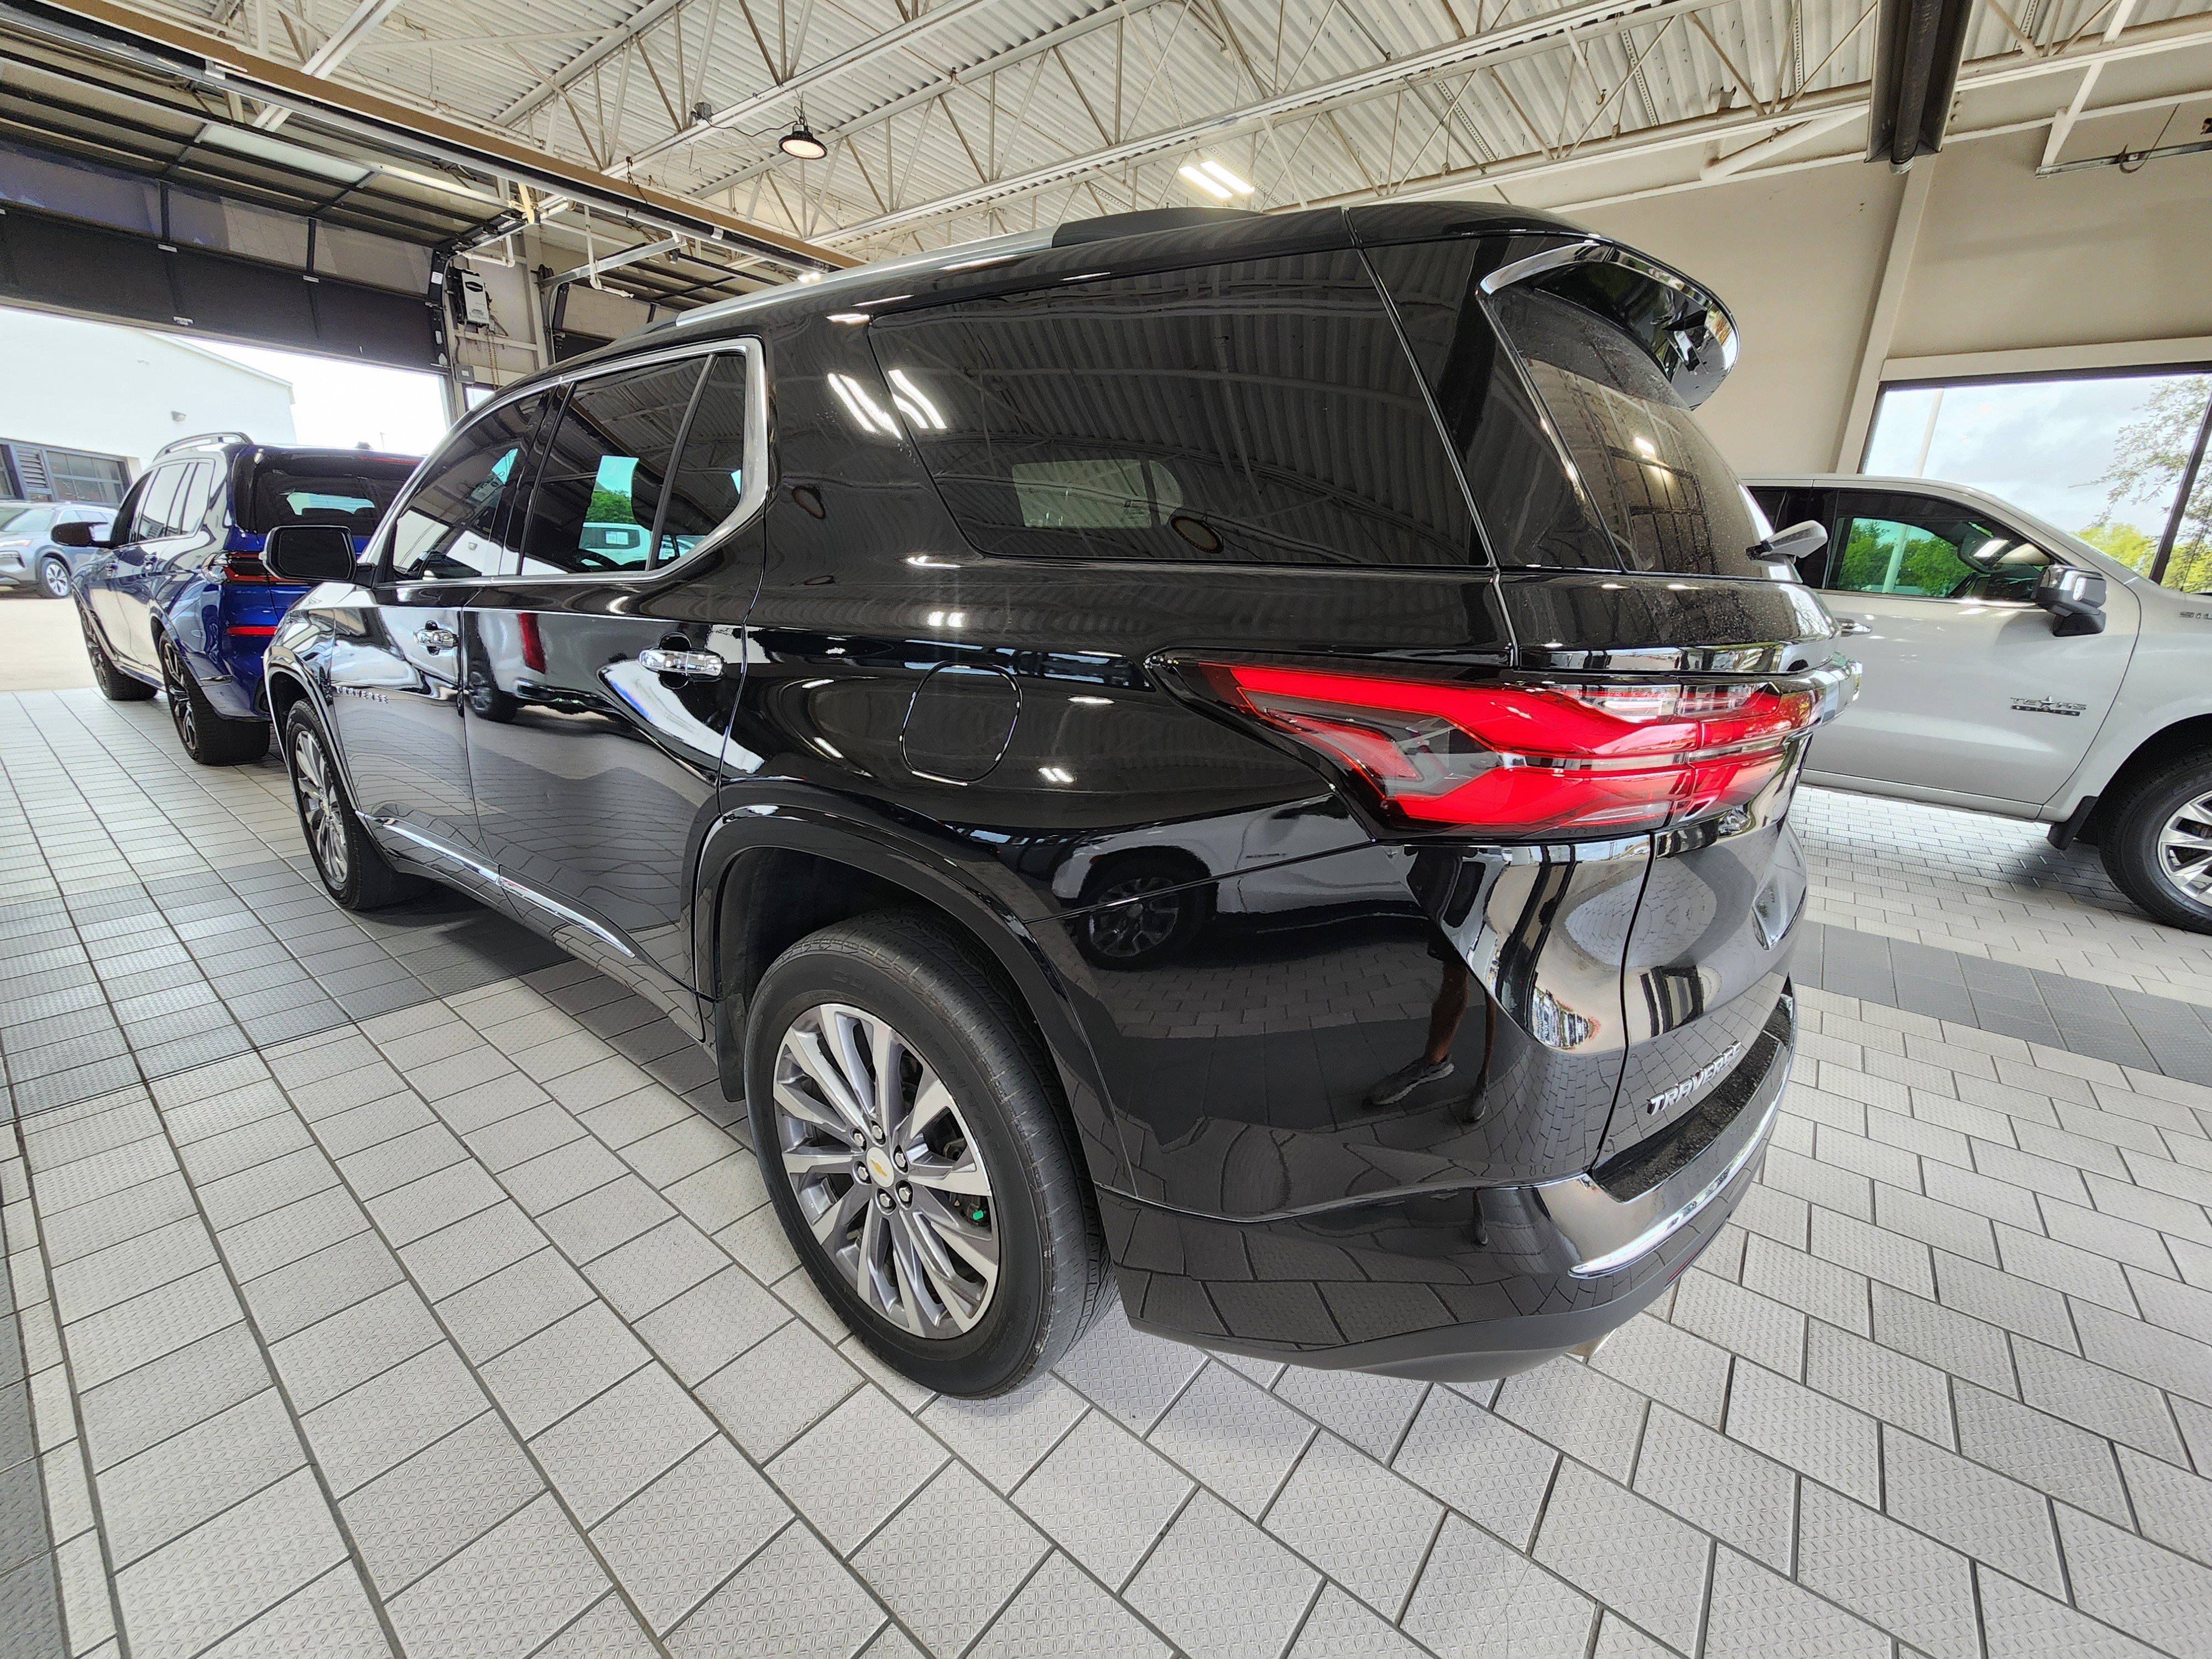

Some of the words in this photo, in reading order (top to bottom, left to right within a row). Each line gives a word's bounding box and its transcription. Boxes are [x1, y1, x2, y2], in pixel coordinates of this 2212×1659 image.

[335, 685, 389, 703] TRAVERSE
[2010, 695, 2087, 710] TEXAS
[1647, 1040, 1741, 1115] TRAVERSE
